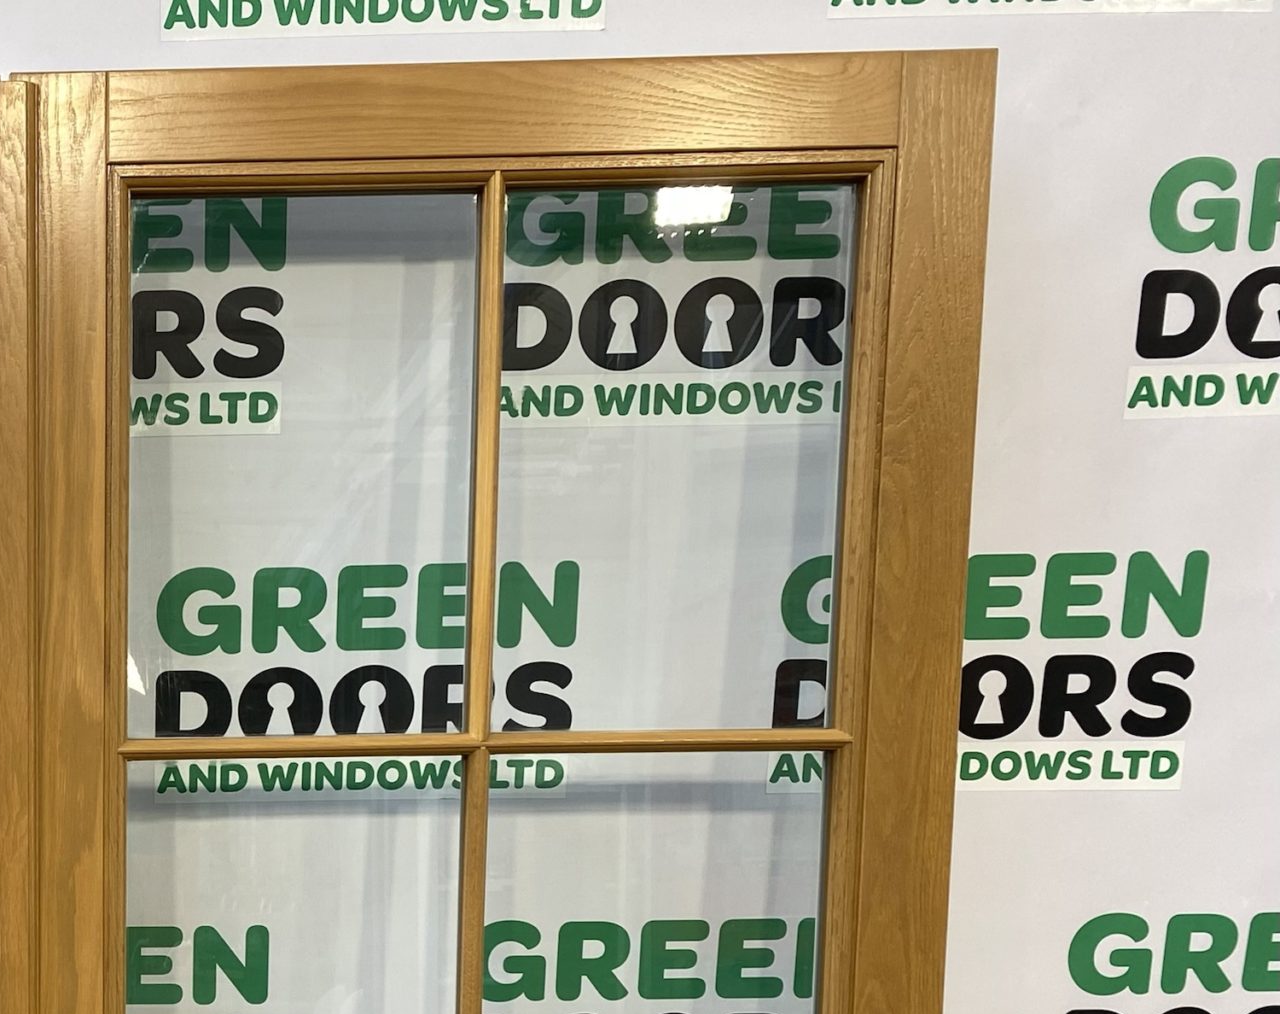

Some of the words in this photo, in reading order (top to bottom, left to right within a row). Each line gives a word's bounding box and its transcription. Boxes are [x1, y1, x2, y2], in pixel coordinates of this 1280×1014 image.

[164, 0, 262, 28] AND
[276, 0, 509, 25] WINDOWS
[200, 391, 278, 424] LTD
[594, 380, 823, 416] WINDOWS
[1128, 374, 1225, 408] AND
[156, 560, 580, 656] GREEN
[157, 761, 248, 794] AND
[489, 758, 564, 790] LTD
[1101, 750, 1180, 781] LTD
[482, 919, 816, 1002] GREE
